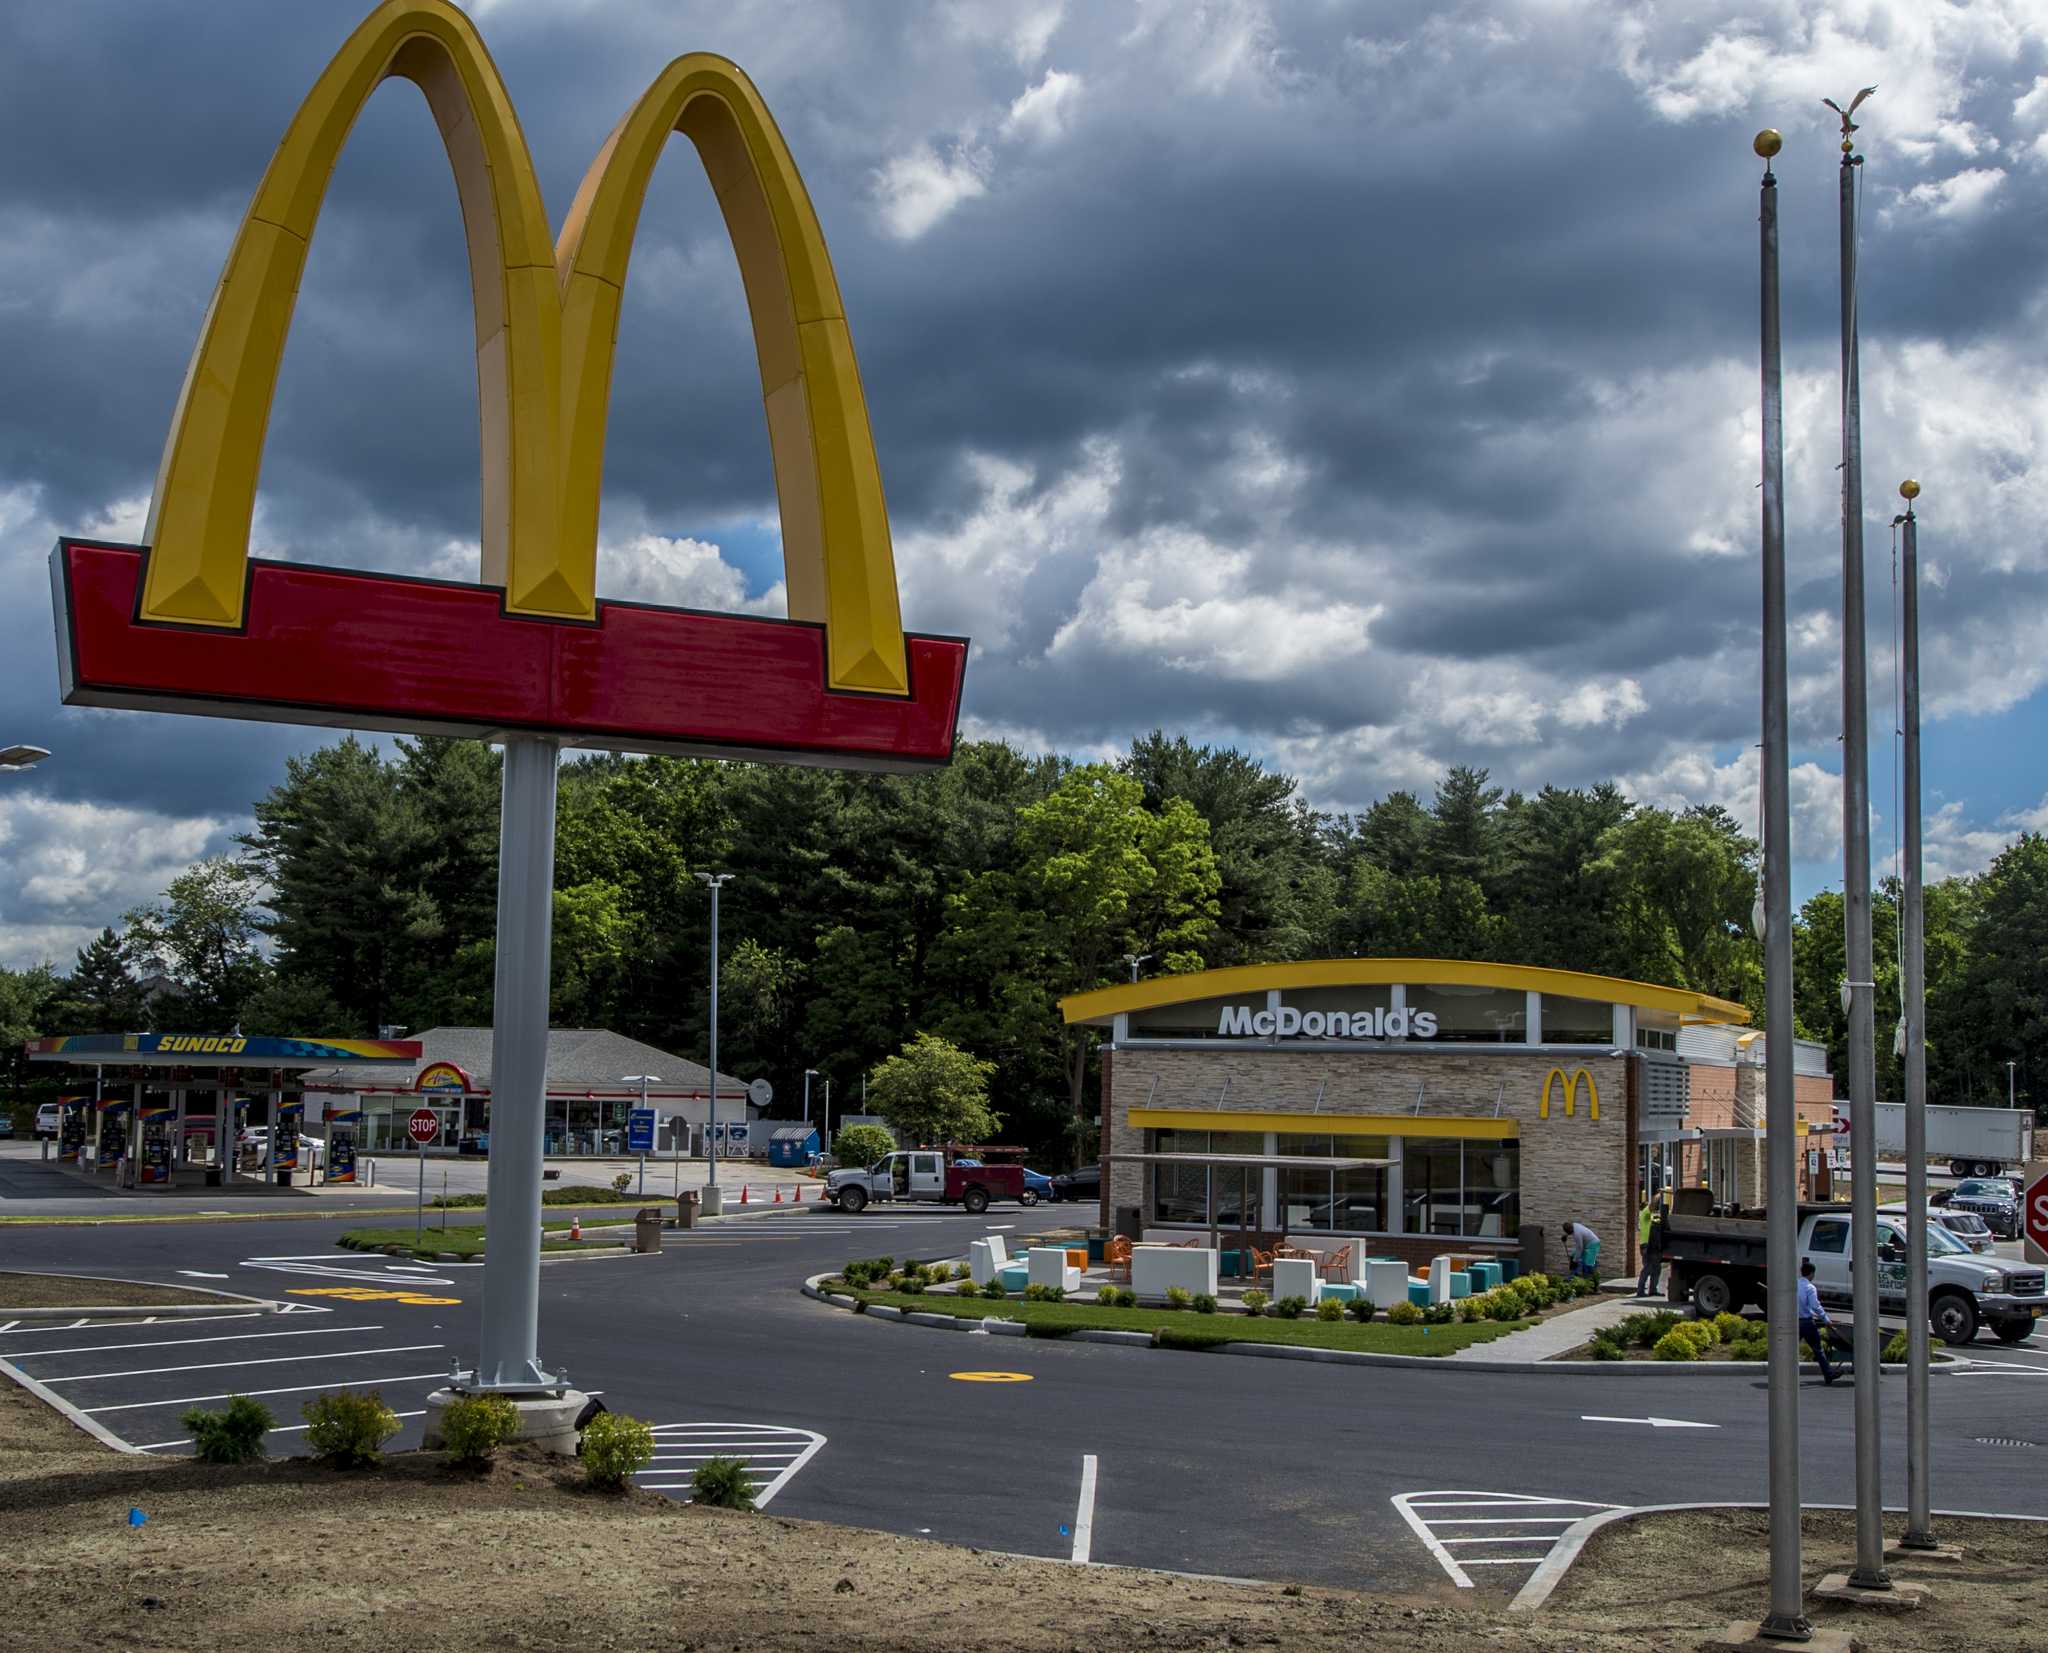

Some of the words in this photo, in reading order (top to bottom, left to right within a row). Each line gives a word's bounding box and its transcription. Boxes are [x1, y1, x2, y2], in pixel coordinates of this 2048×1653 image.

[1218, 1006, 1439, 1038] McDonald's
[157, 1036, 248, 1053] SUNOCO
[410, 1118, 436, 1132] STOP
